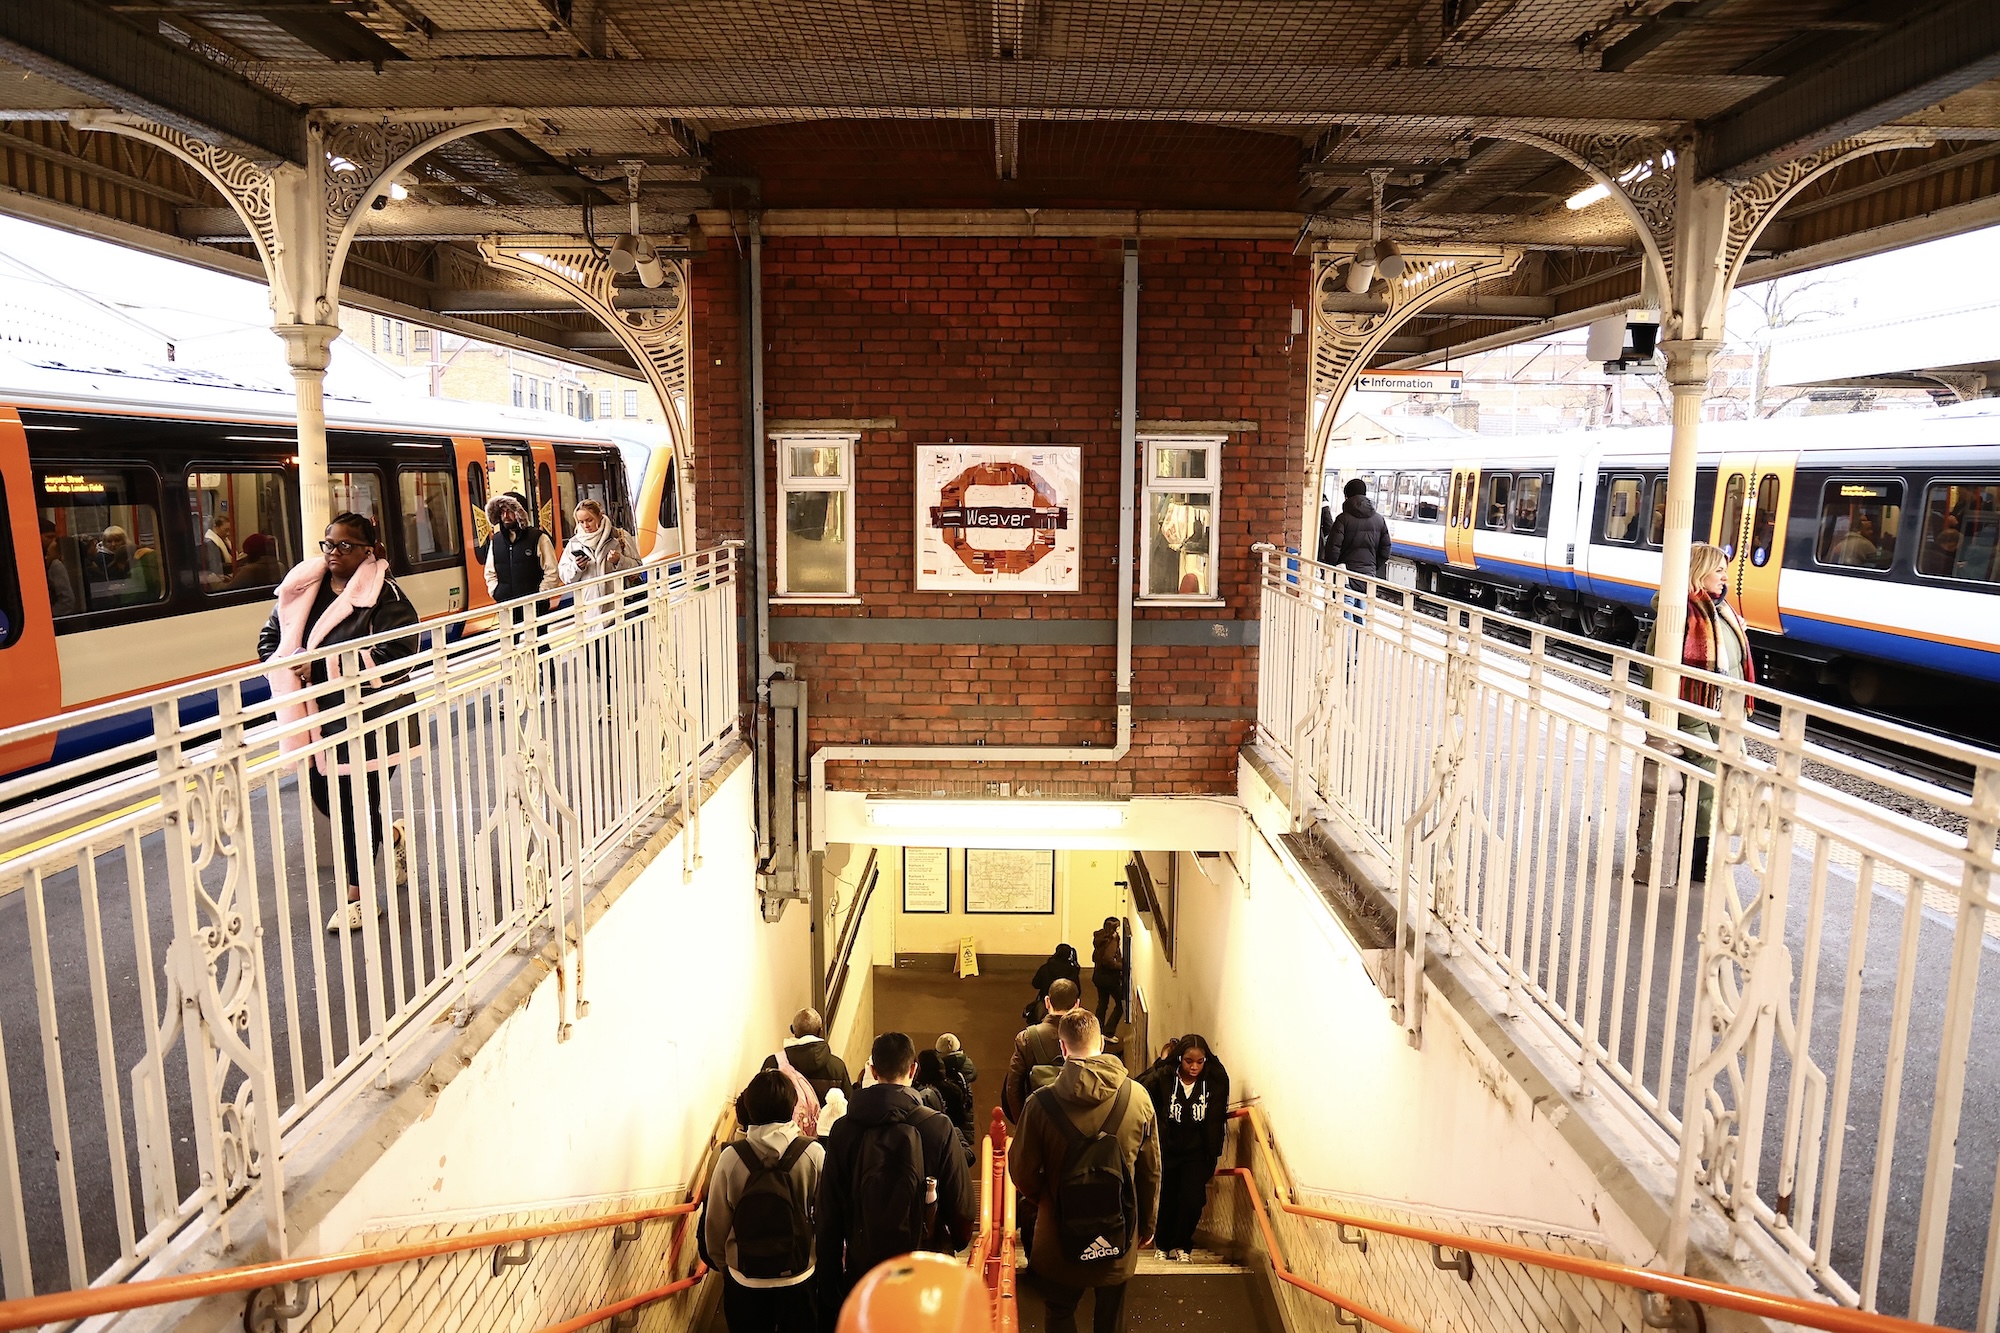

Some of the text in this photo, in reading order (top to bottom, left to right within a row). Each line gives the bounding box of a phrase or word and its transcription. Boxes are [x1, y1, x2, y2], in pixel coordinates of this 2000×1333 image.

[1371, 378, 1433, 388] Information
[71, 484, 89, 492] London
[89, 484, 104, 492] Fields
[966, 509, 1031, 526] Weaver
[1080, 1247, 1120, 1261] adidas
